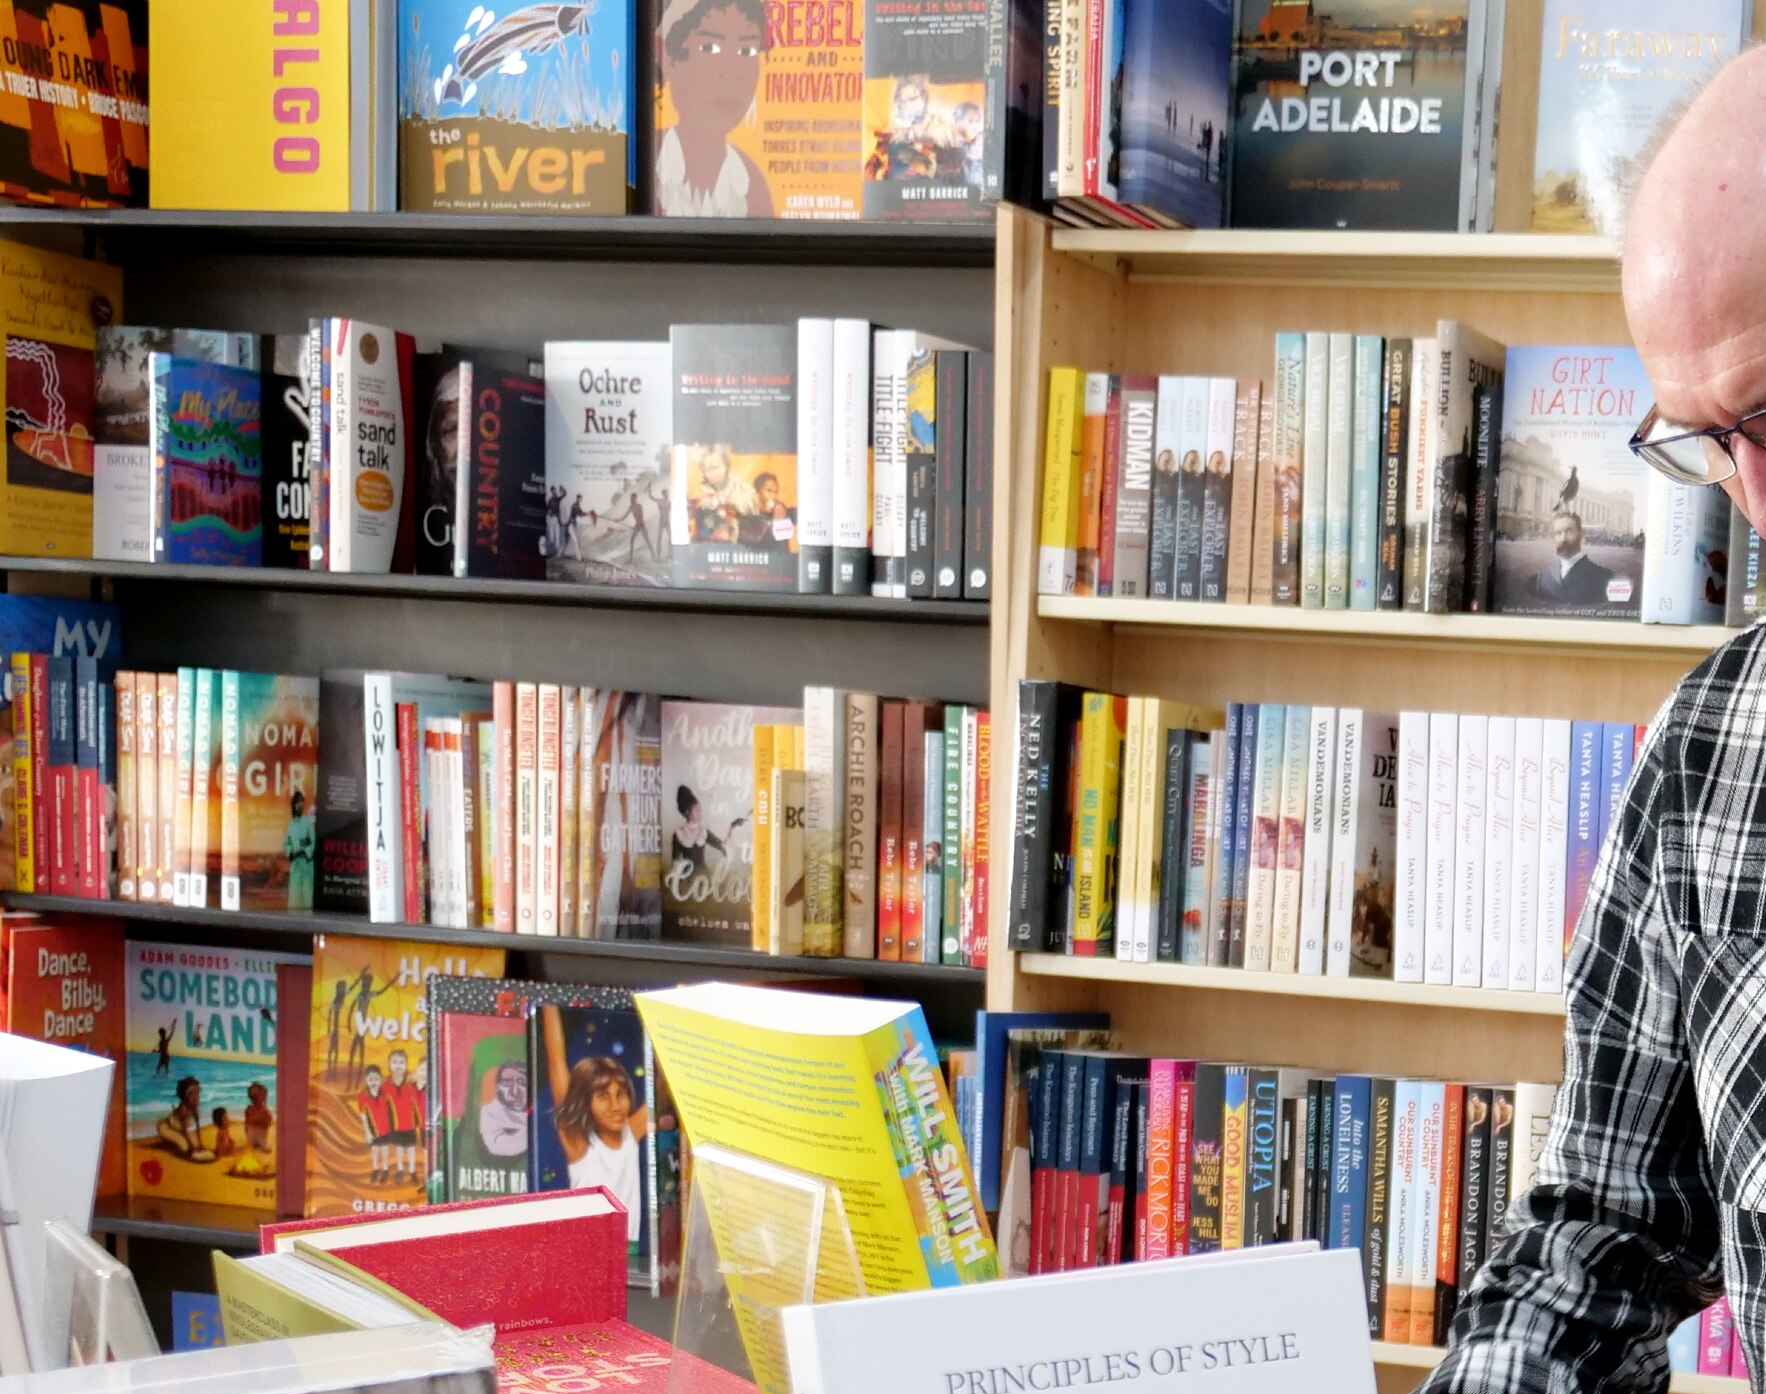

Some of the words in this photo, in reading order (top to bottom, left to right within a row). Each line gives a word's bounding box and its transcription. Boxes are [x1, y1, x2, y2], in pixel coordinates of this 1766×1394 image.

[58, 51, 108, 90] DARK
[806, 51, 838, 68] AND
[1299, 49, 1403, 88] PORT
[429, 126, 461, 145] the
[1252, 98, 1443, 135] ADELAIDE
[430, 133, 605, 196] river
[901, 187, 936, 200] MATT
[939, 188, 968, 200] GARRICK
[579, 367, 643, 395] Ochre
[1390, 350, 1402, 404] GREAT
[1552, 356, 1614, 385] GIRT
[583, 407, 638, 434] Rust
[1530, 388, 1636, 417] NATION
[358, 421, 396, 446] sand
[1124, 400, 1154, 490] KIDMAN
[358, 448, 390, 471] talk
[477, 388, 501, 555] COUNTRY
[1385, 457, 1399, 527] STORIES
[369, 685, 387, 852] LOWITJA
[1312, 720, 1329, 835] VANDEMONIANS
[37, 947, 91, 978] Dance,
[61, 980, 107, 1013] Bilby,
[44, 1010, 96, 1040] Dance
[902, 1041, 944, 1138] WILL
[932, 1142, 988, 1265] SMITH
[1226, 1116, 1242, 1167] GOOD
[1253, 1080, 1276, 1192] UTOPIA
[1336, 1094, 1352, 1194] LONELINESS
[1467, 1137, 1482, 1223] BRANDON
[1192, 1217, 1213, 1228] JESS
[1199, 1228, 1219, 1239] HILL
[1149, 1345, 1195, 1376] OF
[1200, 1332, 1301, 1371] STYLE
